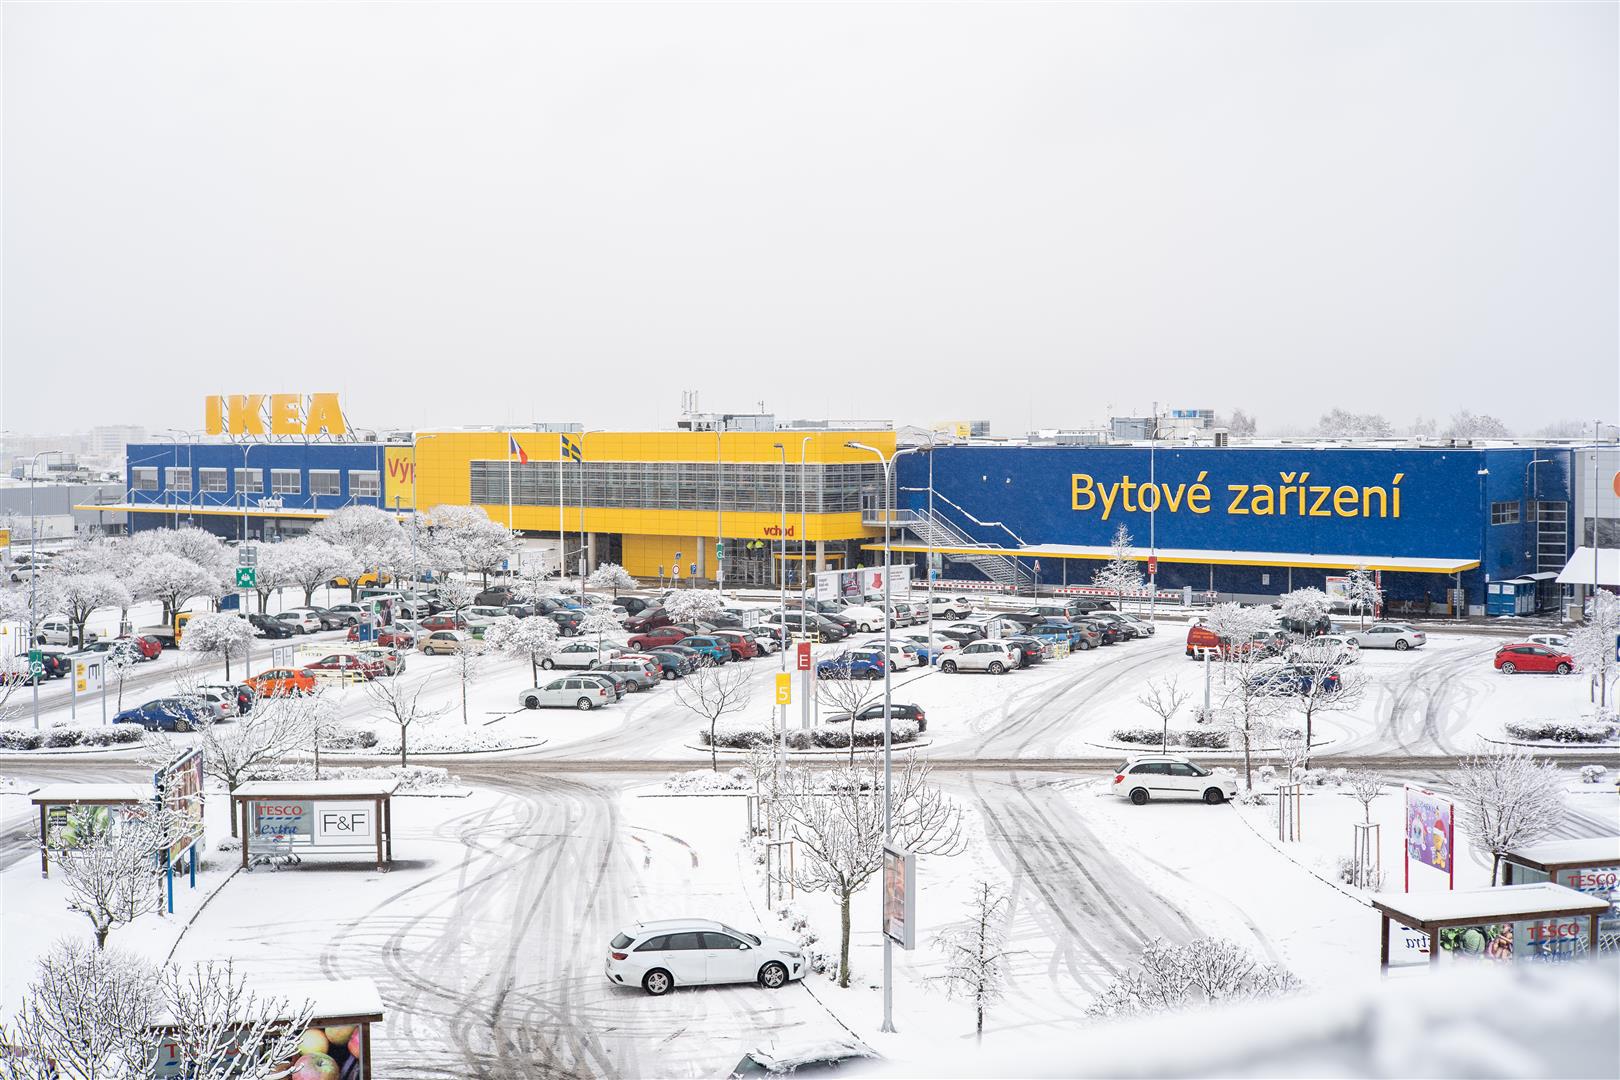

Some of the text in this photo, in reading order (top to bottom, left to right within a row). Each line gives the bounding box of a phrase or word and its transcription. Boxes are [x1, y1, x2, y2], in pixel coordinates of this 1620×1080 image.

[205, 393, 347, 435] IKEA
[1071, 471, 1404, 521] Bytové zařízení
[716, 551, 723, 560] G
[1149, 563, 1155, 572] E
[31, 661, 42, 674] G
[799, 654, 809, 667] E
[778, 686, 789, 701] 5
[257, 805, 303, 816] TESCO
[260, 824, 298, 835] extra
[324, 813, 365, 833] F&F
[1567, 873, 1617, 888] TESCO
[1526, 923, 1580, 942] TESCO
